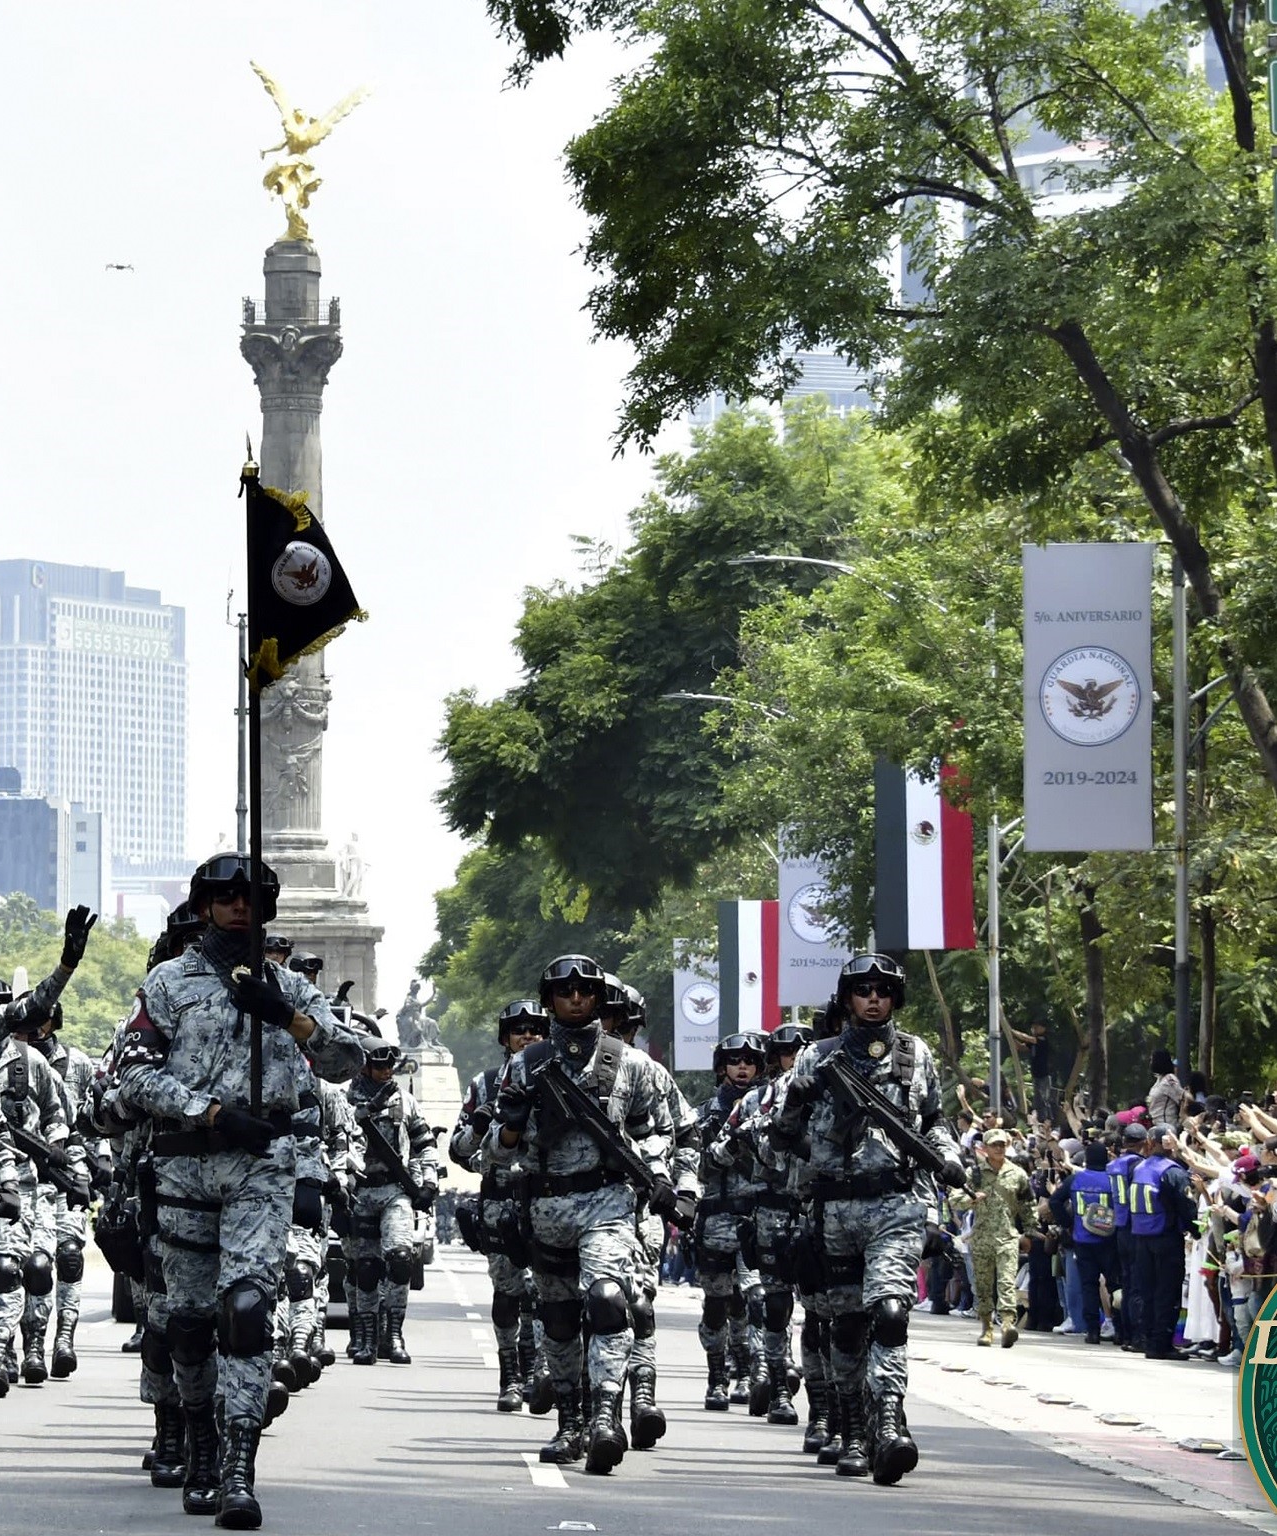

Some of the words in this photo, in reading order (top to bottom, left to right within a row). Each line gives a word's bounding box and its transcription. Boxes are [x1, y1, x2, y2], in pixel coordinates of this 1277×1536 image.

[1056, 610, 1143, 623] ANIVERSARIO
[1047, 652, 1087, 688] GUARDIA
[1088, 651, 1133, 688] NACIONAL
[1043, 770, 1138, 785] 2019-2024
